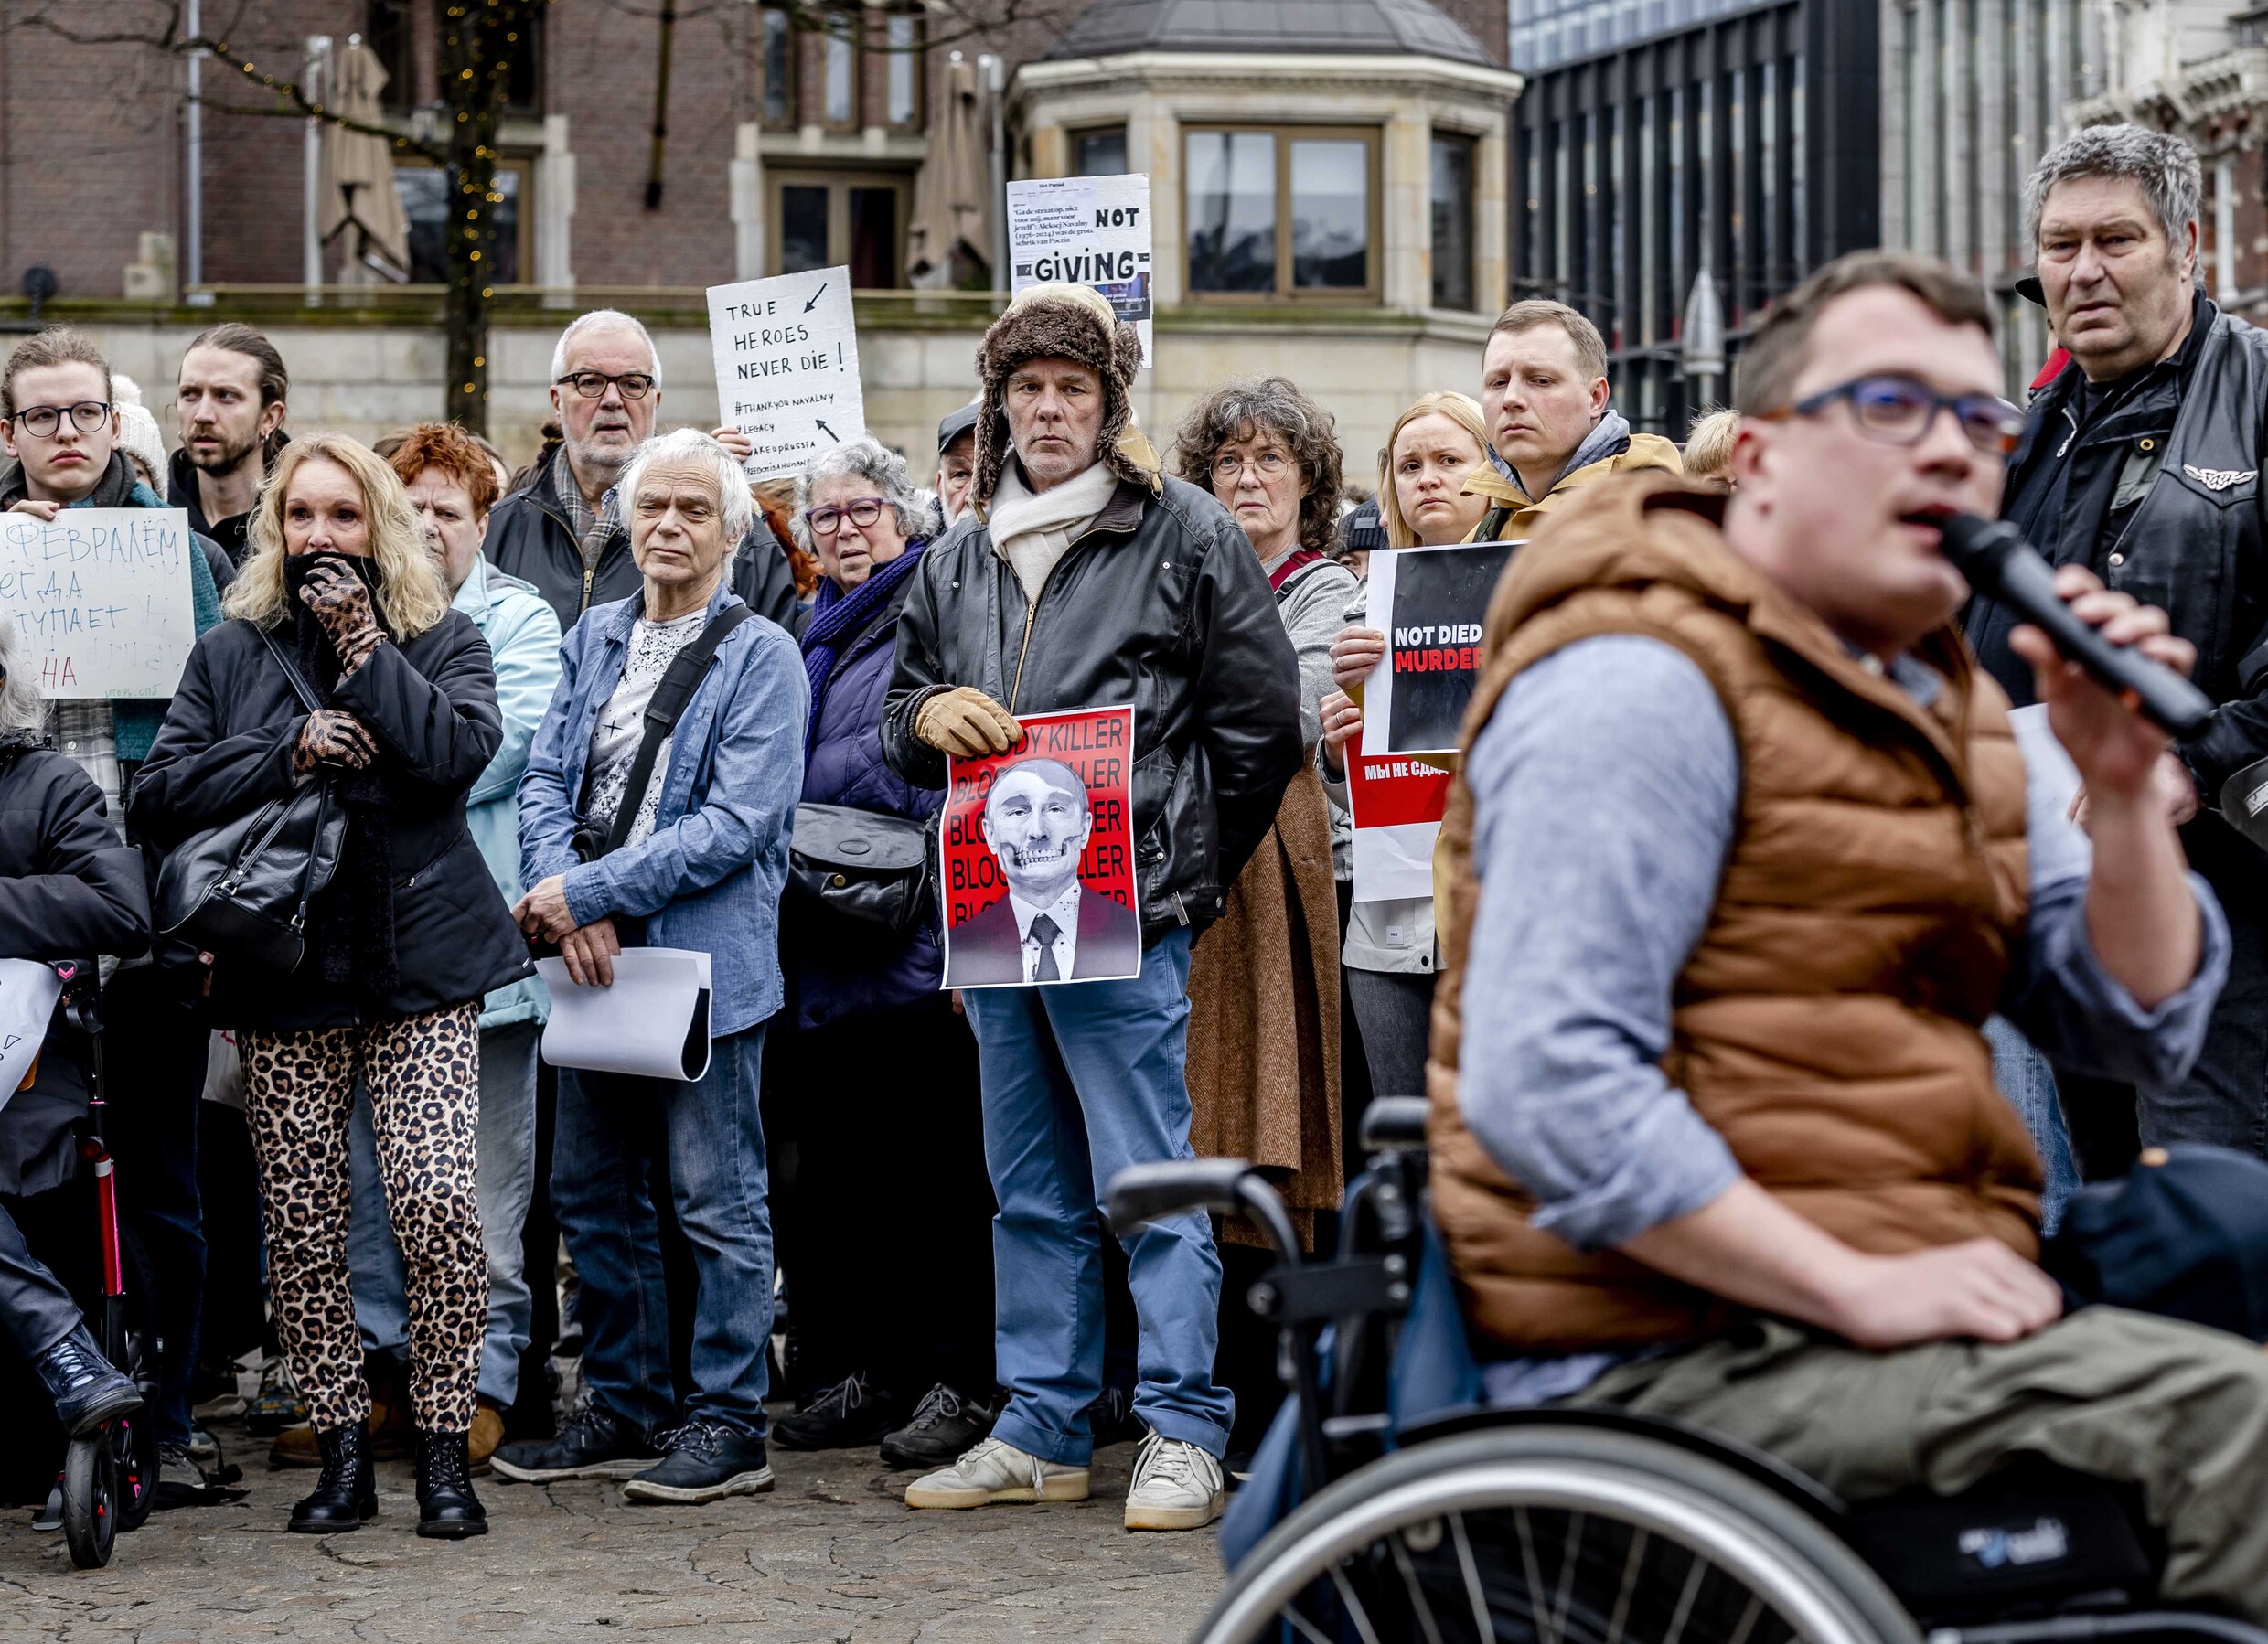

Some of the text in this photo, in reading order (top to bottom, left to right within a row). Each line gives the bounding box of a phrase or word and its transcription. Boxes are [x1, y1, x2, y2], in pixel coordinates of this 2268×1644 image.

[1062, 220, 1088, 229] Navalny
[1096, 208, 1139, 228] NOT
[1076, 228, 1095, 236] grote
[726, 301, 776, 321] TRUE
[734, 324, 808, 351] HEROES
[737, 358, 792, 379] NEVER
[1395, 624, 1482, 646] NOT DIED
[1048, 718, 1123, 753] KILLER
[1364, 763, 1391, 780] МЫ
[1392, 762, 1409, 778] НЕ
